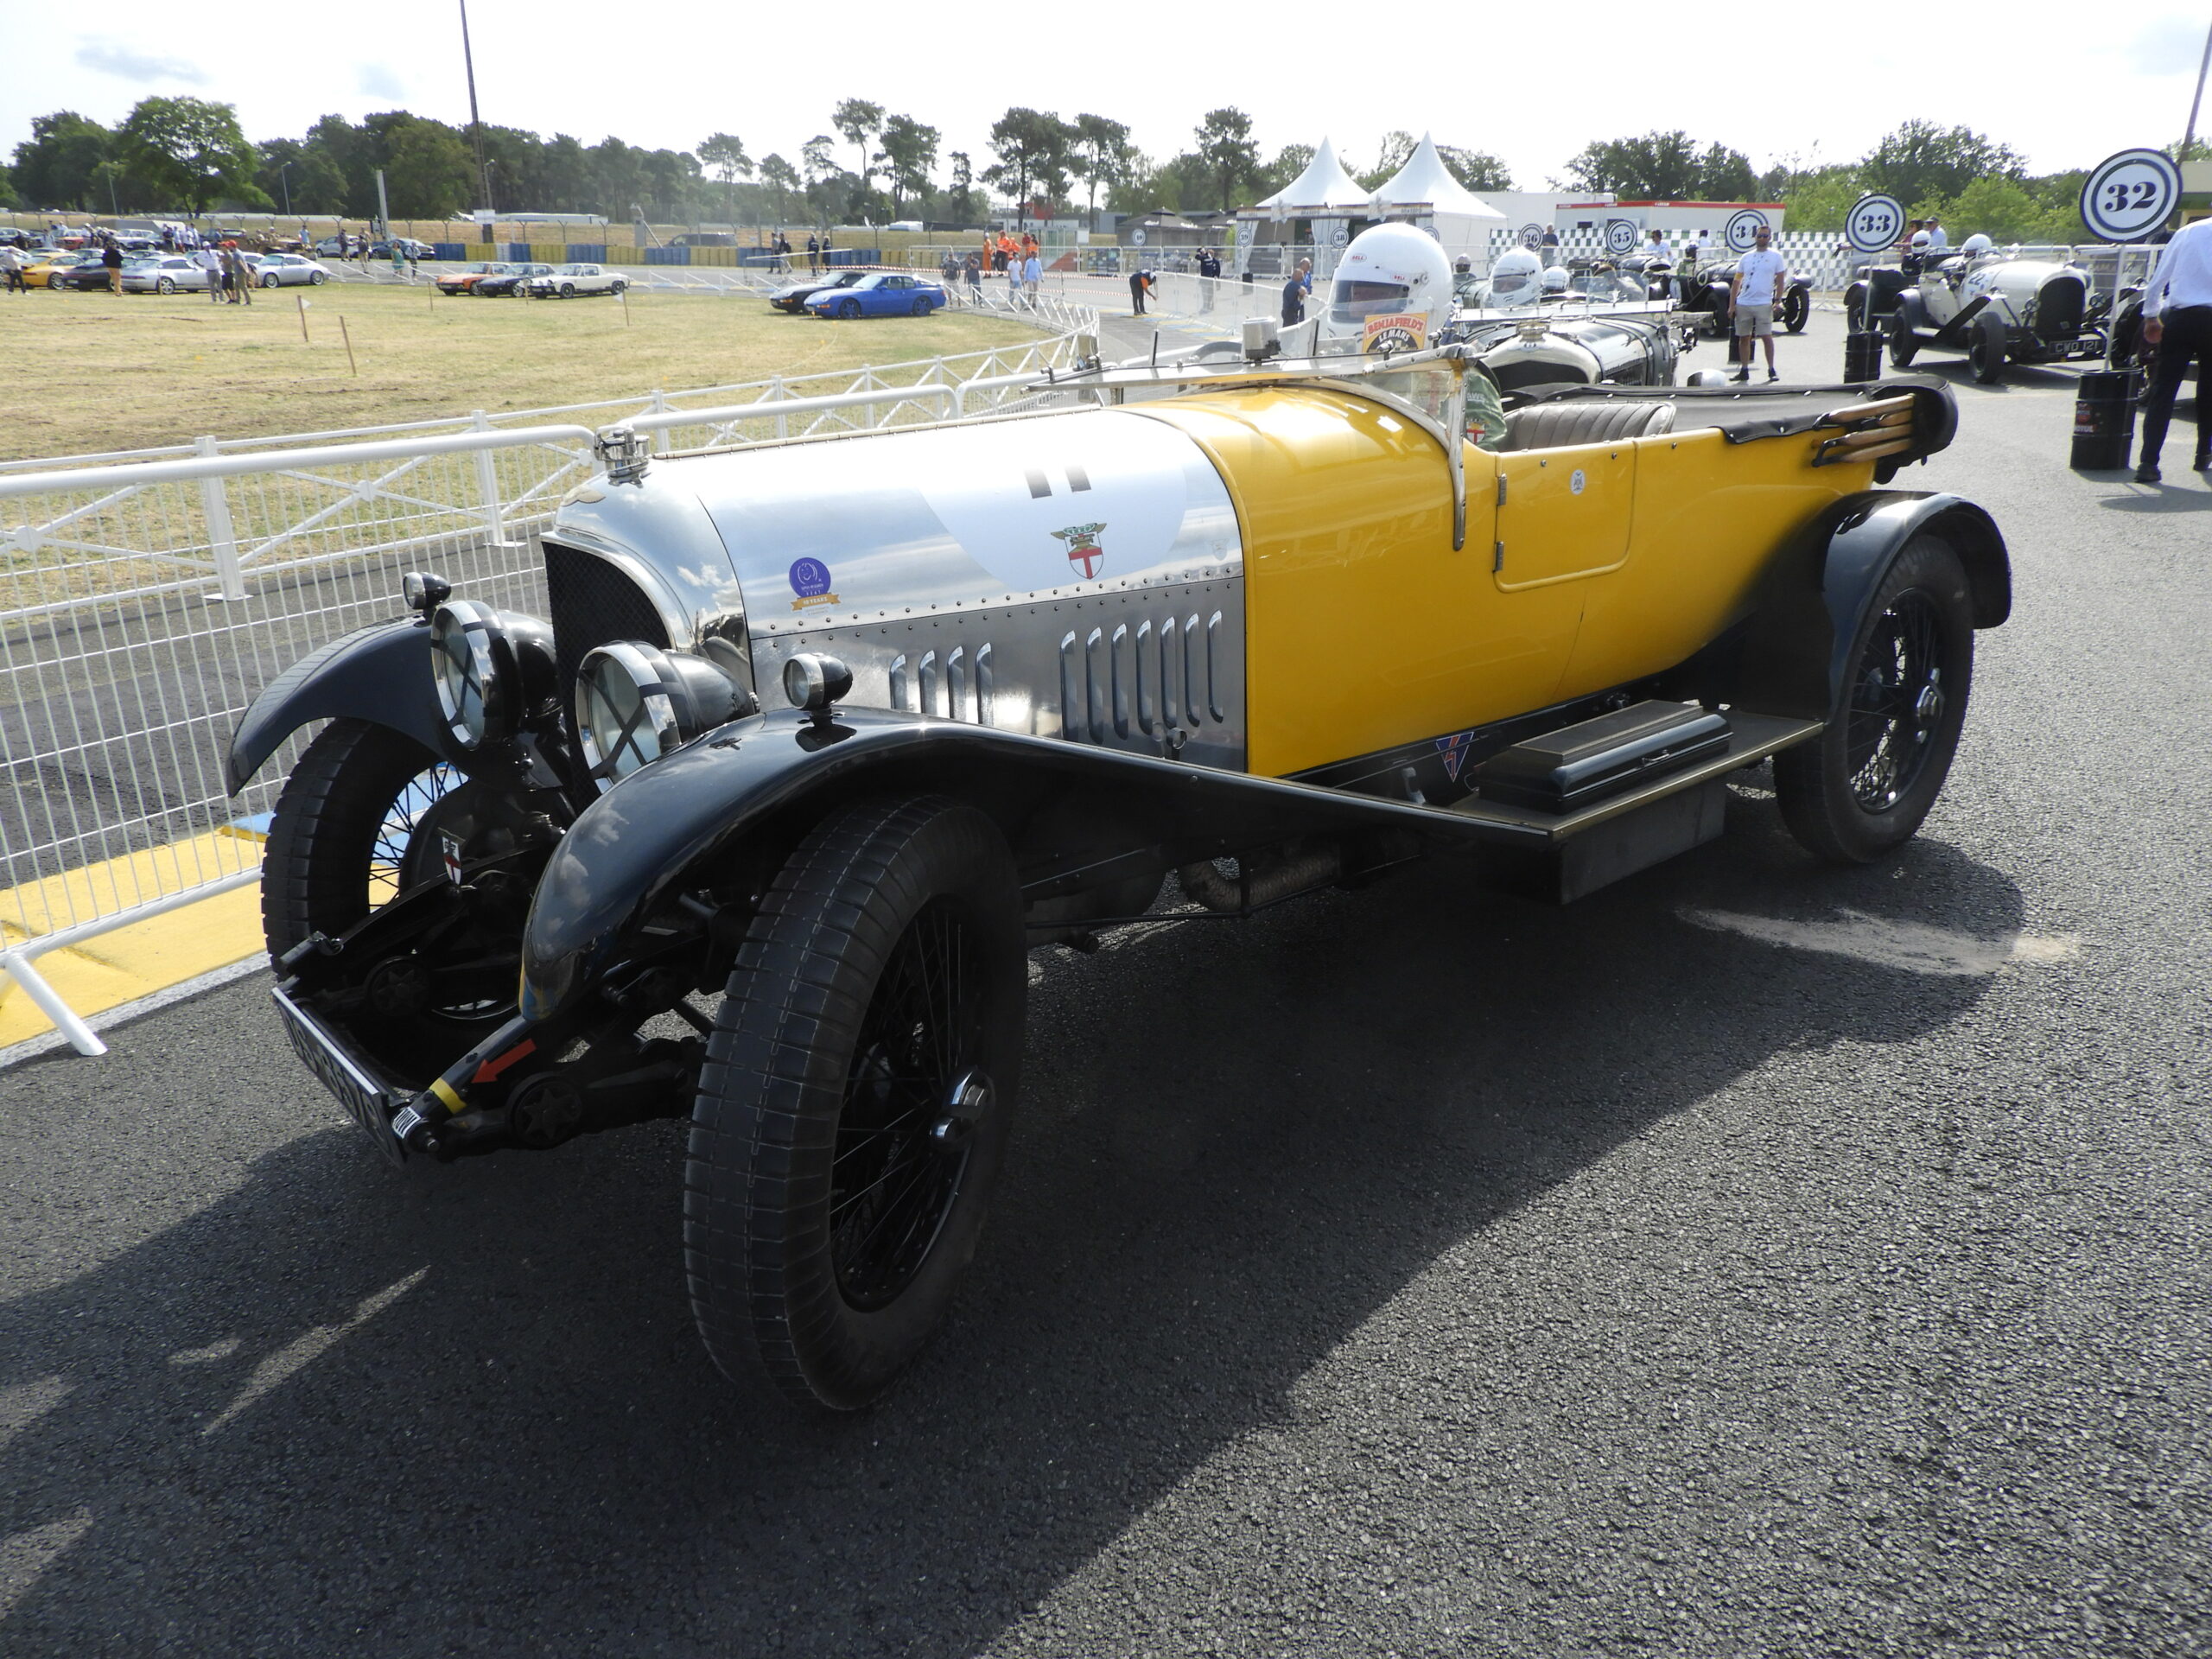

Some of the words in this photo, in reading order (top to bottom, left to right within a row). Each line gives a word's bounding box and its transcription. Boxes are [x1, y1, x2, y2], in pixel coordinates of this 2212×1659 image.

[2105, 181, 2157, 213] 32
[1859, 214, 1891, 232] 33
[1613, 232, 1630, 244] 35
[1735, 225, 1758, 238] 34
[1524, 234, 1538, 243] 36
